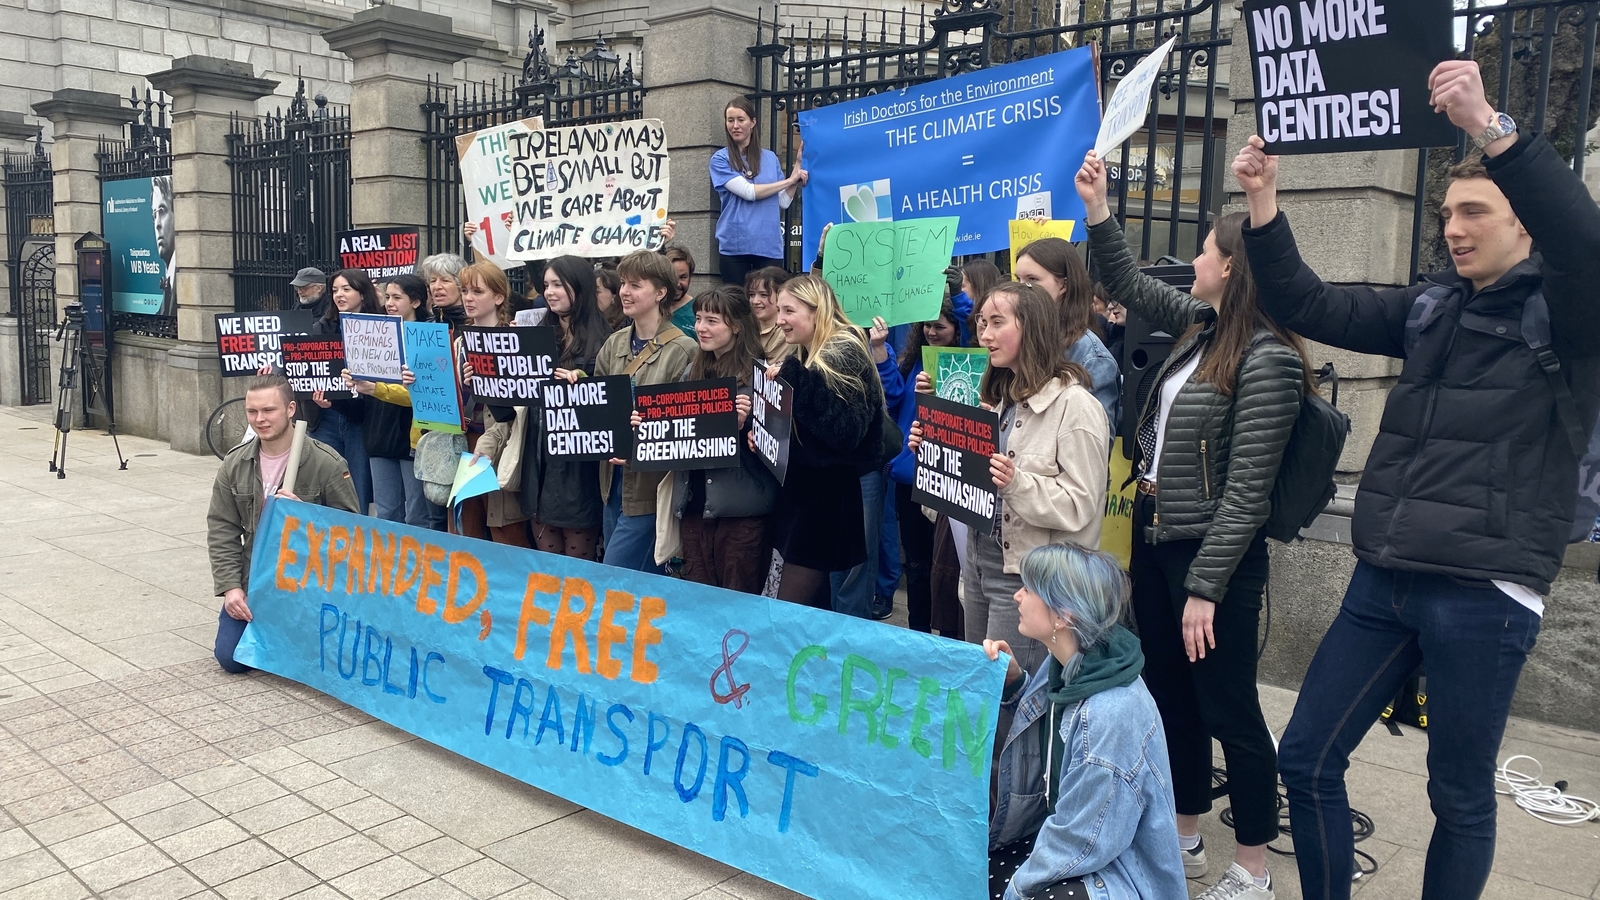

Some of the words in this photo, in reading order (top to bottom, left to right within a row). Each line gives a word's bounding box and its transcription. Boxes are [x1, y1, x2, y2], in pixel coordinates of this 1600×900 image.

[1252, 5, 1293, 52] NO
[1300, 0, 1387, 45] MORE
[1258, 49, 1326, 98] DATA
[843, 108, 868, 126] Irish
[872, 100, 917, 120] Doctors
[920, 93, 937, 110] for
[941, 89, 963, 105] the
[967, 67, 1054, 99] Environment
[885, 126, 917, 148] THE
[922, 109, 996, 141] CLIMATE
[1001, 95, 1062, 125] CRISIS
[1262, 88, 1401, 143] CENTRES!
[477, 129, 517, 156] THI
[509, 128, 608, 161] IRELAND
[615, 125, 664, 151] MAY
[513, 162, 545, 196] BE
[558, 154, 623, 193] SMALL
[631, 153, 667, 183] BUT
[901, 196, 913, 213] A
[917, 183, 983, 211] HEALTH
[989, 173, 1042, 200] CRISIS
[515, 195, 552, 224] WE
[561, 193, 603, 218] CARE
[609, 187, 662, 212] ABOUT
[340, 238, 350, 253] A
[351, 235, 385, 252] REAL
[388, 233, 417, 250] JUST
[513, 223, 584, 253] CLIMATE
[591, 225, 661, 250] CHANGE
[1012, 226, 1032, 240] How
[341, 250, 417, 268] TRANSITION!
[832, 225, 947, 271] SYSTEM
[131, 261, 142, 273] WB
[142, 261, 160, 274] Yeats
[366, 268, 380, 278] THE
[382, 266, 398, 278] RICH
[399, 265, 414, 275] PAY!
[898, 284, 934, 303] CHANGE
[218, 317, 241, 335] WE
[244, 316, 280, 334] NEED
[345, 320, 360, 334] NO
[365, 321, 389, 335] LNG
[220, 335, 256, 353] FREE
[282, 342, 329, 351] PRO-CORPORATE
[348, 335, 392, 348] TERMINALS
[406, 327, 445, 347] MAKE
[463, 331, 482, 352] WE
[484, 333, 520, 353] NEED
[222, 352, 283, 371] TRANSPO
[291, 351, 332, 360] PRO-POLLUTER
[346, 348, 359, 360] NO
[362, 348, 381, 360] NEW
[384, 350, 399, 361] OIL
[413, 354, 436, 372] love
[467, 354, 496, 375] FREE
[497, 355, 553, 376] PUBLIC
[286, 362, 308, 376] STOP
[310, 361, 330, 375] THE
[353, 363, 365, 374] GAS
[412, 384, 446, 396] CLIMATE
[544, 385, 565, 408] NO
[567, 382, 607, 406] MORE
[638, 391, 696, 407] PRO-CORPORATE
[698, 388, 729, 401] POLICIES
[753, 365, 763, 394] NO
[763, 373, 783, 411] MORE
[416, 400, 453, 415] CHANGE
[647, 405, 700, 419] PRO-POLLUTER
[702, 401, 733, 414] POLICIES
[753, 391, 766, 426] DATA
[546, 408, 579, 431] DATA
[638, 420, 670, 440] STOP
[672, 418, 696, 438] THE
[918, 405, 963, 432] PRO-CORPORATE
[964, 421, 992, 440] POLICIES
[547, 431, 614, 455] CENTRES!
[636, 436, 736, 462] GREENWASHING
[752, 417, 779, 467] CENTRES!
[924, 425, 967, 450] PRO-POLLUTER
[967, 438, 995, 458] POLICIES
[917, 441, 940, 467] STOP
[942, 447, 962, 477] THE
[916, 466, 994, 520] GREENWASHING
[275, 516, 492, 641] EXPANDED,
[514, 572, 666, 684] FREE
[709, 629, 751, 710] &
[785, 645, 990, 777] GREEN
[319, 603, 446, 703] PUBLIC
[483, 664, 819, 833] TRANSPORT
